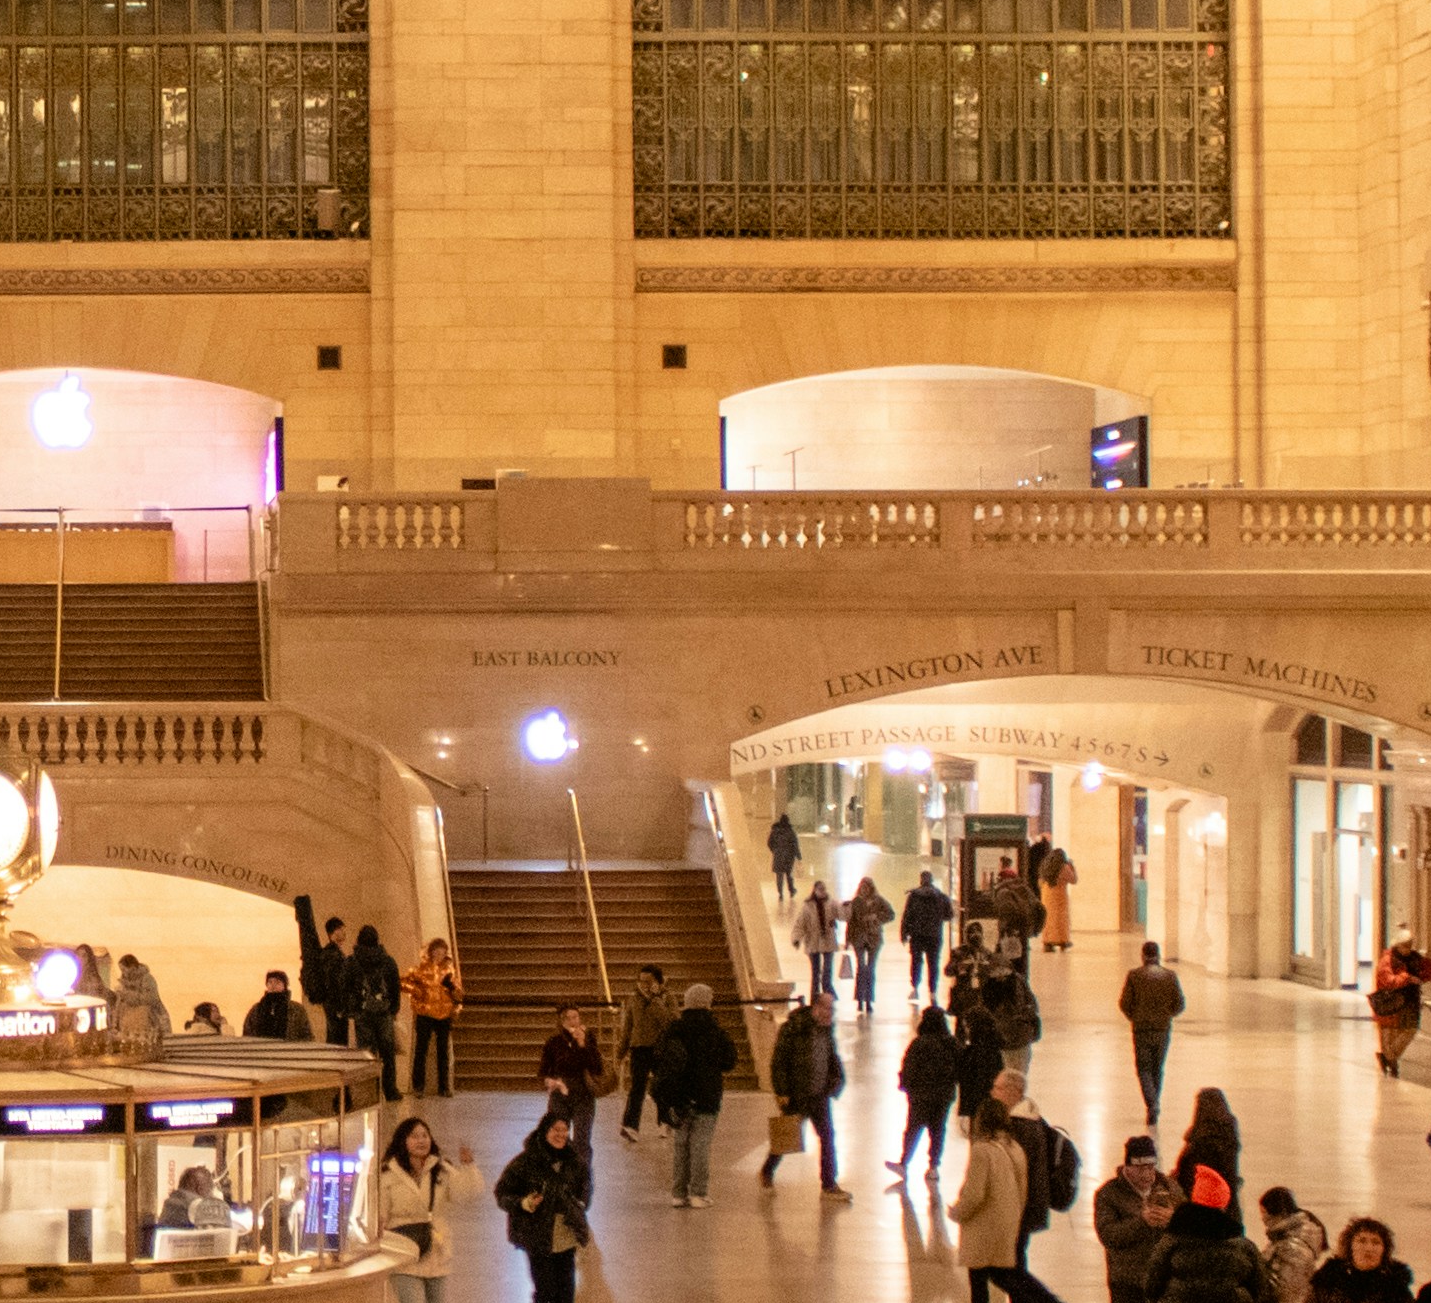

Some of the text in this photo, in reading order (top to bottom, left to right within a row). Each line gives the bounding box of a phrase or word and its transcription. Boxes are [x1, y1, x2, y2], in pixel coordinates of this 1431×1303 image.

[473, 651, 622, 666] EAST BALCONY
[824, 645, 1043, 698] LEXINGTON AVE
[1140, 645, 1379, 704] TICKET MACHINES
[772, 731, 855, 757] STREET
[860, 726, 956, 746] PASSAGE
[969, 727, 1064, 749] SUBWAY
[105, 844, 178, 867] DINING
[182, 853, 290, 895] CONCOURSE
